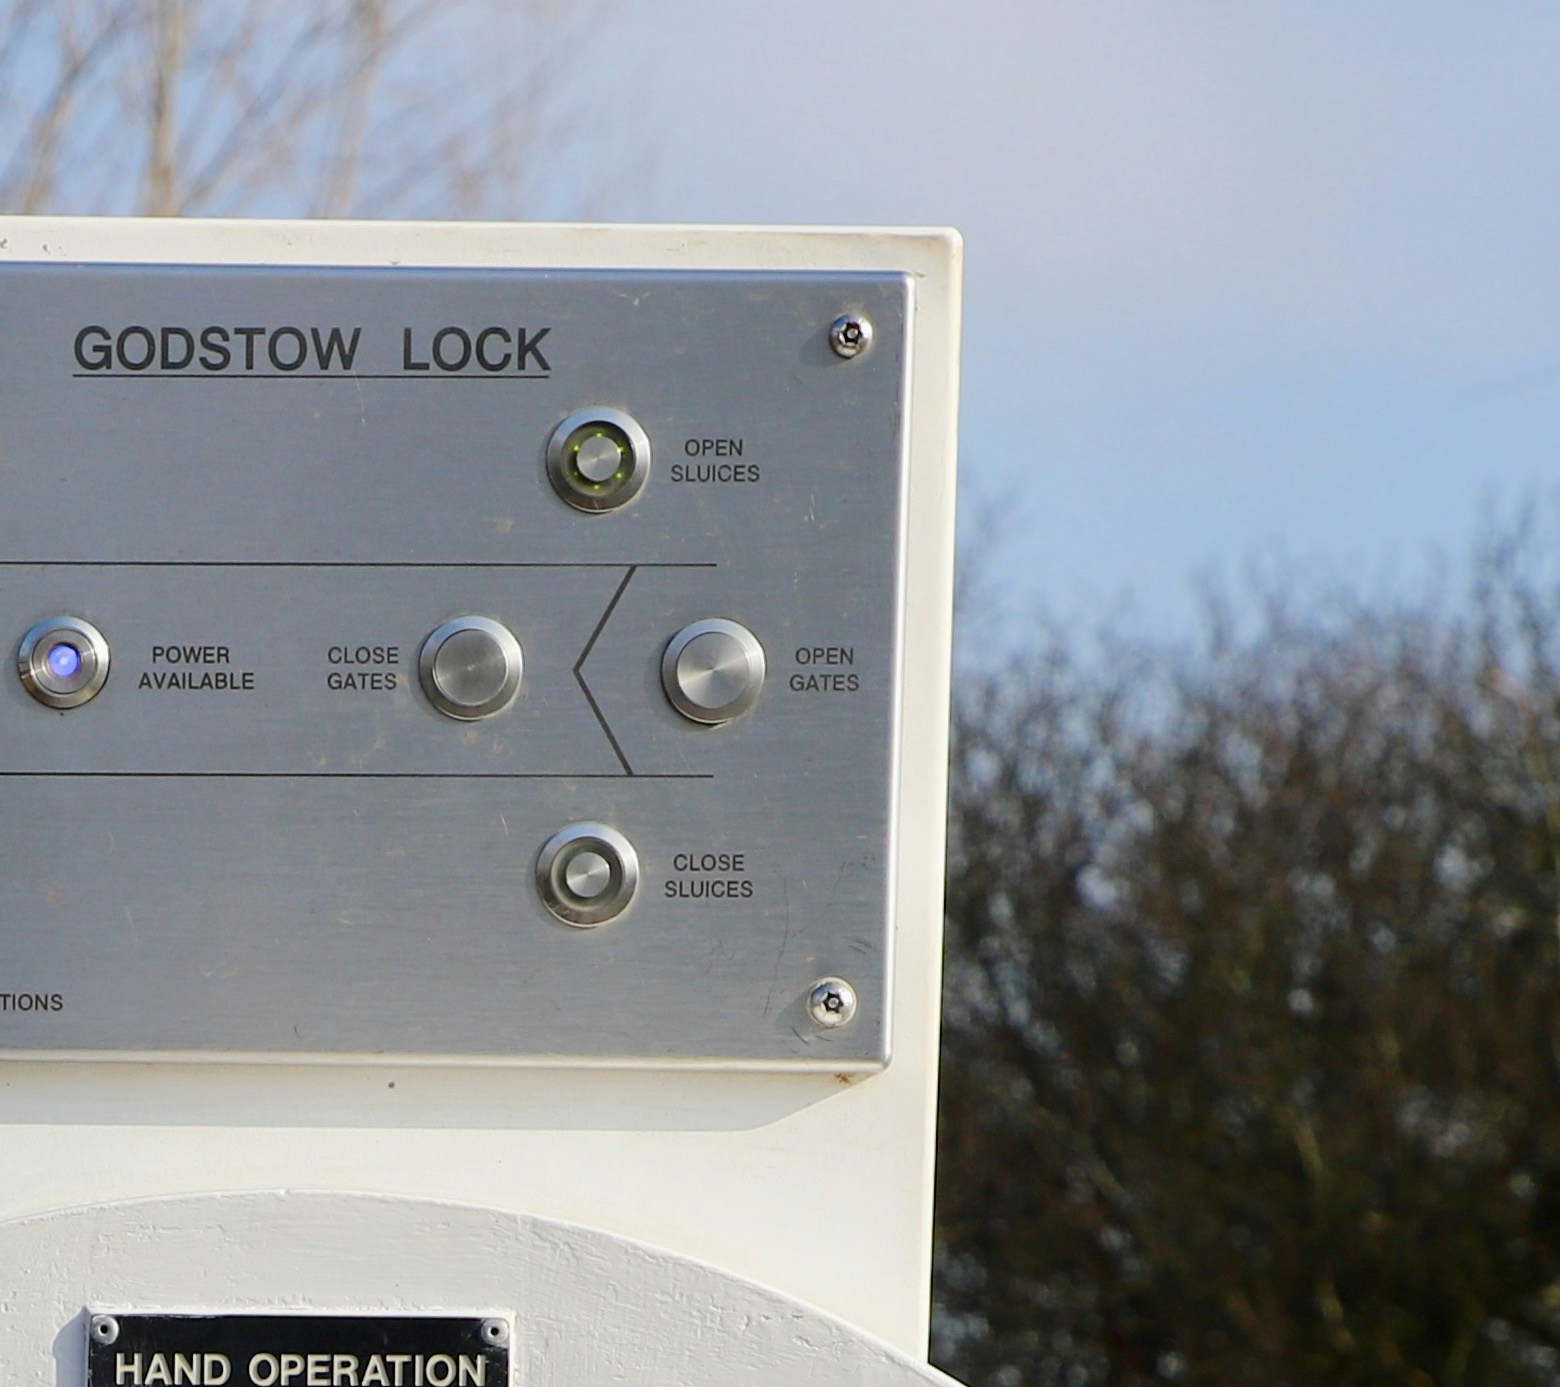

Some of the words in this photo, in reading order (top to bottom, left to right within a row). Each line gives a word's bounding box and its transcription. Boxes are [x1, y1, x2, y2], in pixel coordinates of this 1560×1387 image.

[74, 325, 362, 371] GODSTOW
[403, 326, 552, 371] LOCK
[684, 438, 743, 457] OPEN
[670, 464, 760, 483] SLUICES
[152, 645, 230, 664] POWER
[327, 645, 399, 665] CLOSE
[795, 646, 855, 666] OPEN
[138, 671, 255, 690] AVAILABLE
[327, 671, 397, 691] GATES
[789, 672, 860, 692] GATES
[673, 852, 746, 872] CLOSE
[664, 879, 754, 898] SLUICES
[115, 1352, 231, 1386] HAND
[248, 1353, 487, 1387] OPERATION
